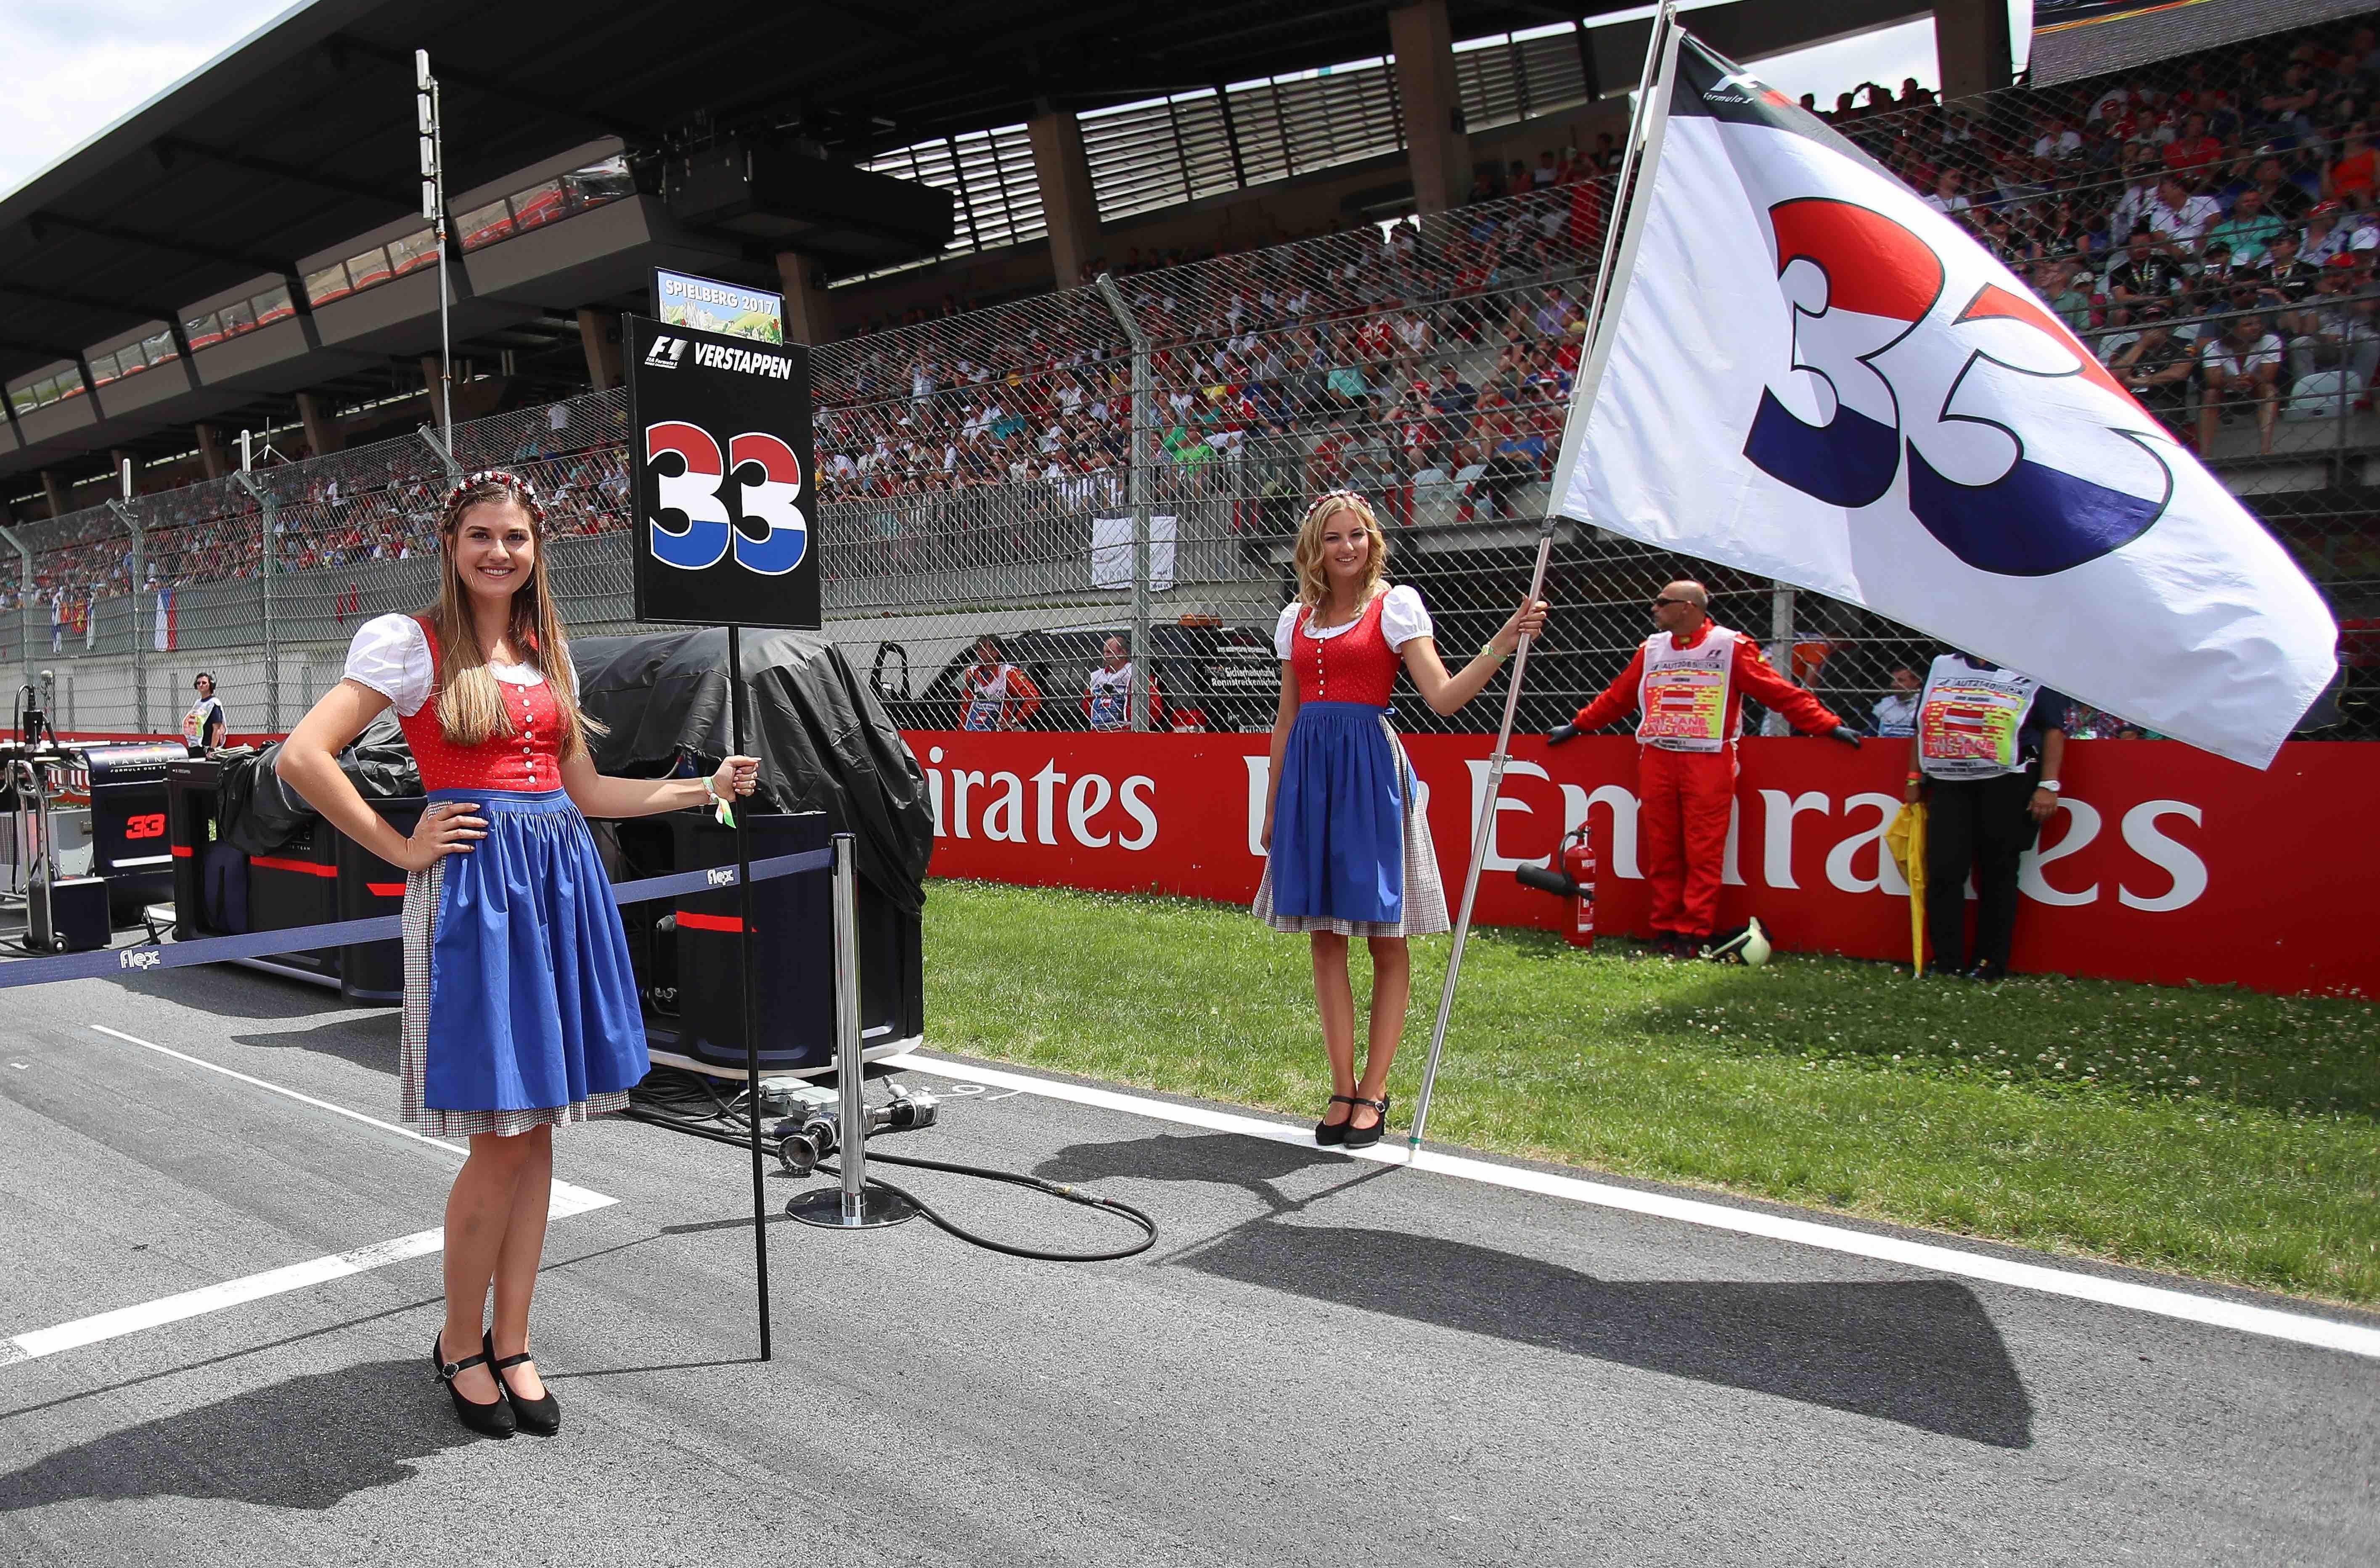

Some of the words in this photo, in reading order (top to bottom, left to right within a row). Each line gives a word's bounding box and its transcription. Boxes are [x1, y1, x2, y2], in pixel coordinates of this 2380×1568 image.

[1703, 93, 1743, 103] Formula
[665, 280, 739, 308] SPIELBERG
[742, 296, 775, 315] 2017
[648, 336, 688, 360] F1
[694, 342, 792, 380] VERSTAPPEN
[1742, 196, 2181, 577] 33
[645, 420, 807, 576] 33
[109, 756, 175, 766] RACING
[925, 746, 1158, 851] irates
[126, 814, 165, 838] 33
[120, 949, 161, 970] flex
